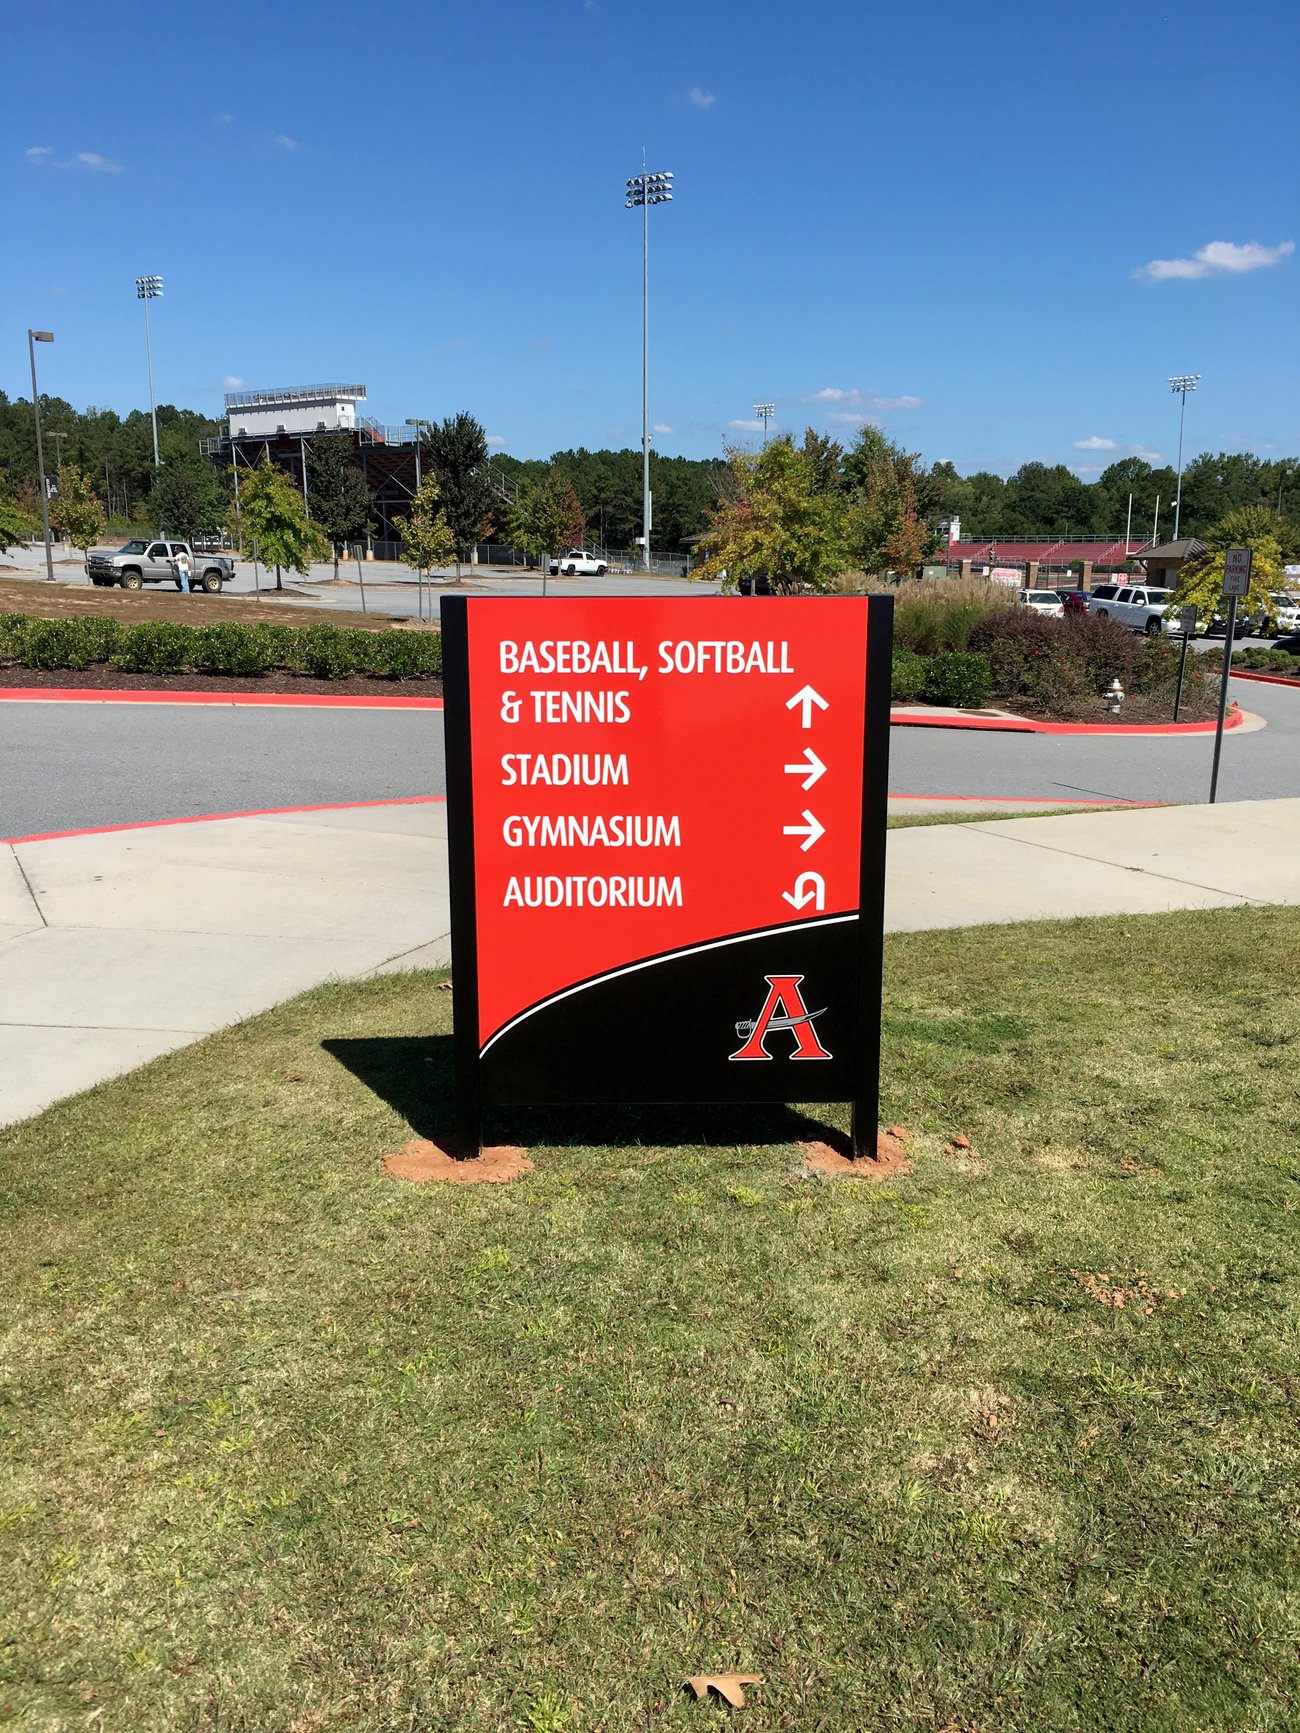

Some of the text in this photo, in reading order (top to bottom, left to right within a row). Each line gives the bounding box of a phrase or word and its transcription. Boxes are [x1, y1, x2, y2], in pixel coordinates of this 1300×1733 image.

[1225, 565, 1248, 574] PARKING
[1232, 553, 1242, 563] NO
[500, 640, 795, 681] BASEBALL, SOFTBALL
[501, 690, 631, 724] & TENNIS
[501, 753, 629, 786] STADIUM
[502, 815, 681, 847] GYMNASIUM
[503, 875, 683, 907] AUDITORIUM
[728, 974, 833, 1061] A
